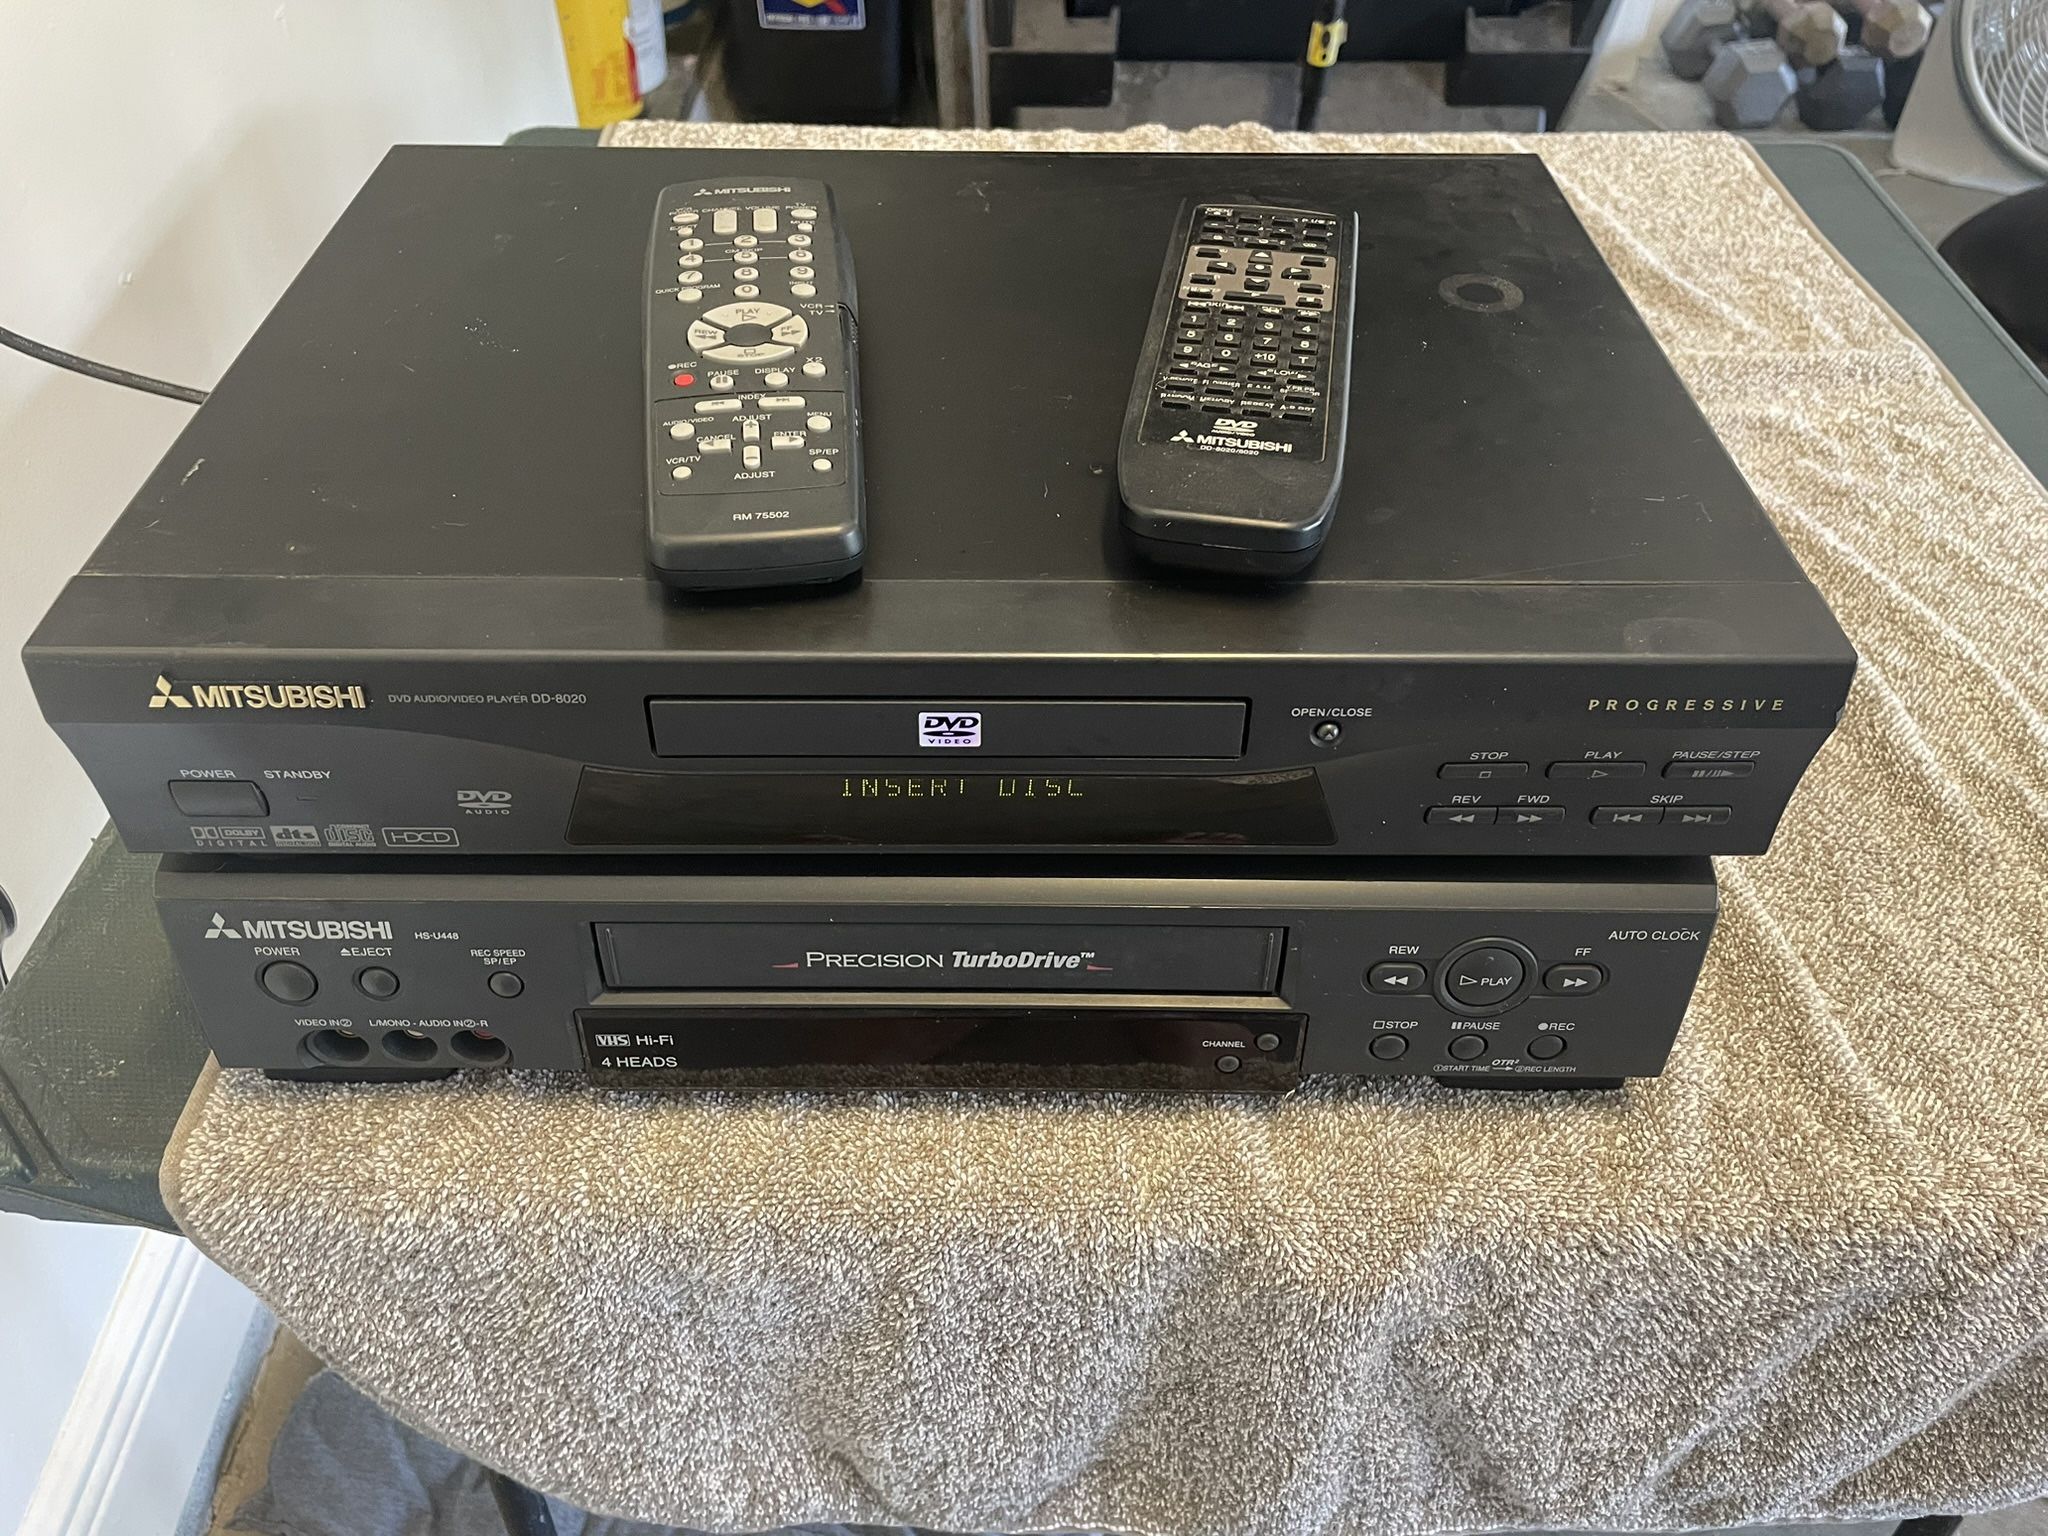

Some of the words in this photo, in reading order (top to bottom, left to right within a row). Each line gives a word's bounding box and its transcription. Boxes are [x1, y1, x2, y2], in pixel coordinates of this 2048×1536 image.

[714, 186, 792, 195] MITSUBISHI
[1301, 325, 1312, 333] 4
[1263, 337, 1272, 345] 7
[1254, 353, 1276, 361] +10
[707, 369, 740, 377] PAUSE
[754, 366, 796, 374] DISPLAY
[732, 414, 772, 422] ADJUST
[1214, 418, 1258, 428] DVD
[696, 434, 736, 442] CANCEL
[1196, 434, 1292, 453] MITSUBISHI
[666, 455, 702, 464] VCR/TV
[734, 470, 776, 480] ADJUST
[733, 513, 752, 521] RM
[755, 511, 790, 519] 75502
[191, 684, 366, 710] MITSUBISHI
[387, 694, 412, 704] DVD
[413, 694, 484, 704] AUDIO/VIDEO
[487, 694, 529, 704] PLAYER
[531, 693, 587, 704] DD-8020
[1588, 699, 1785, 712] PROGRESSIVE
[1291, 707, 1373, 717] OPEN/CLOSE
[924, 716, 979, 732] DVD
[1469, 750, 1509, 761] STOP
[1584, 750, 1623, 760] PLAY
[1672, 750, 1761, 760] PAUSE/STEP
[179, 769, 236, 779] POWER
[263, 769, 332, 780] STANDBY
[457, 790, 512, 803] DVD
[1452, 795, 1481, 804] REV
[1517, 795, 1550, 804] FWD
[1650, 795, 1684, 804] SKIP
[196, 839, 269, 847] DIGITAL
[242, 920, 393, 940] MITSUBISHI
[414, 931, 459, 941] HS-U448
[1607, 930, 1648, 941] AUTO
[1651, 930, 1701, 941] CLOCK
[254, 946, 301, 957] POWER
[352, 947, 392, 957] EJECT
[470, 949, 491, 957] REC
[493, 949, 526, 958] SPEED
[1388, 945, 1420, 955] REW
[1574, 947, 1592, 957] FF
[483, 957, 517, 966] SP/EP
[805, 951, 944, 968] PRECISION
[1480, 976, 1513, 987] PLAY
[294, 1019, 327, 1027] VIDEO
[419, 1019, 450, 1028] AUDIO
[1385, 1020, 1419, 1030] STOP
[1462, 1021, 1501, 1031] PAUSE
[1548, 1021, 1576, 1031] REC
[595, 1034, 631, 1047] VHS
[636, 1034, 675, 1046] Hi-Fi
[1202, 1040, 1246, 1048] CHANNEL
[601, 1057, 612, 1067] 4
[616, 1056, 678, 1068] HEADS
